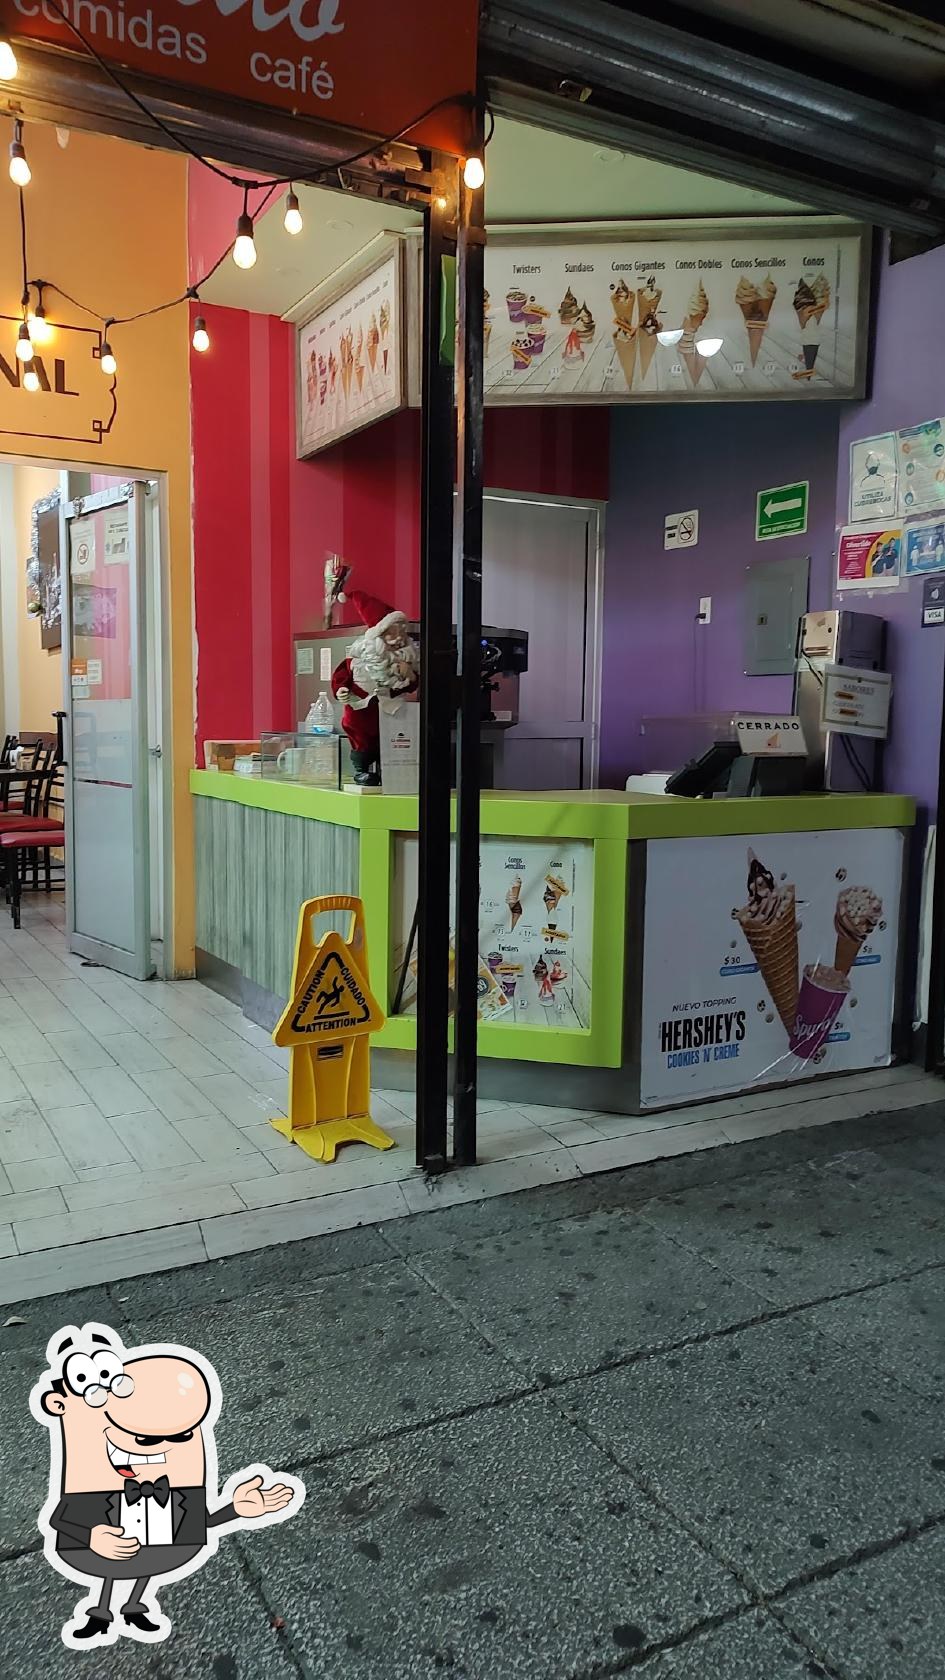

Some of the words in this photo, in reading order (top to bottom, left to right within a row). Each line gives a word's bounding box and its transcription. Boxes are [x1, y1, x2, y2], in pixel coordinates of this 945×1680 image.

[17, 0, 207, 64] comidas
[250, 51, 335, 99] café
[565, 262, 594, 274] Sundaes
[611, 261, 632, 271] Conos
[634, 260, 666, 272] Gigantes
[675, 260, 696, 269] Conos
[698, 259, 723, 269] Dobles
[731, 258, 752, 268] Conos
[754, 257, 786, 268] Sencillos
[803, 256, 825, 266] Conos
[512, 264, 541, 274] Twisters
[927, 611, 942, 619] VISA
[737, 721, 800, 731] CERRADO
[297, 968, 325, 1014] CAUTION
[340, 967, 367, 1006] CUIDADO
[672, 1002, 701, 1012] NUEVO
[702, 996, 737, 1008] TOPPING
[305, 1017, 357, 1033] ATTENTION
[661, 1010, 746, 1053] HERSHEY'S
[667, 1050, 700, 1069] COOKIES
[713, 1043, 740, 1061] CREME
